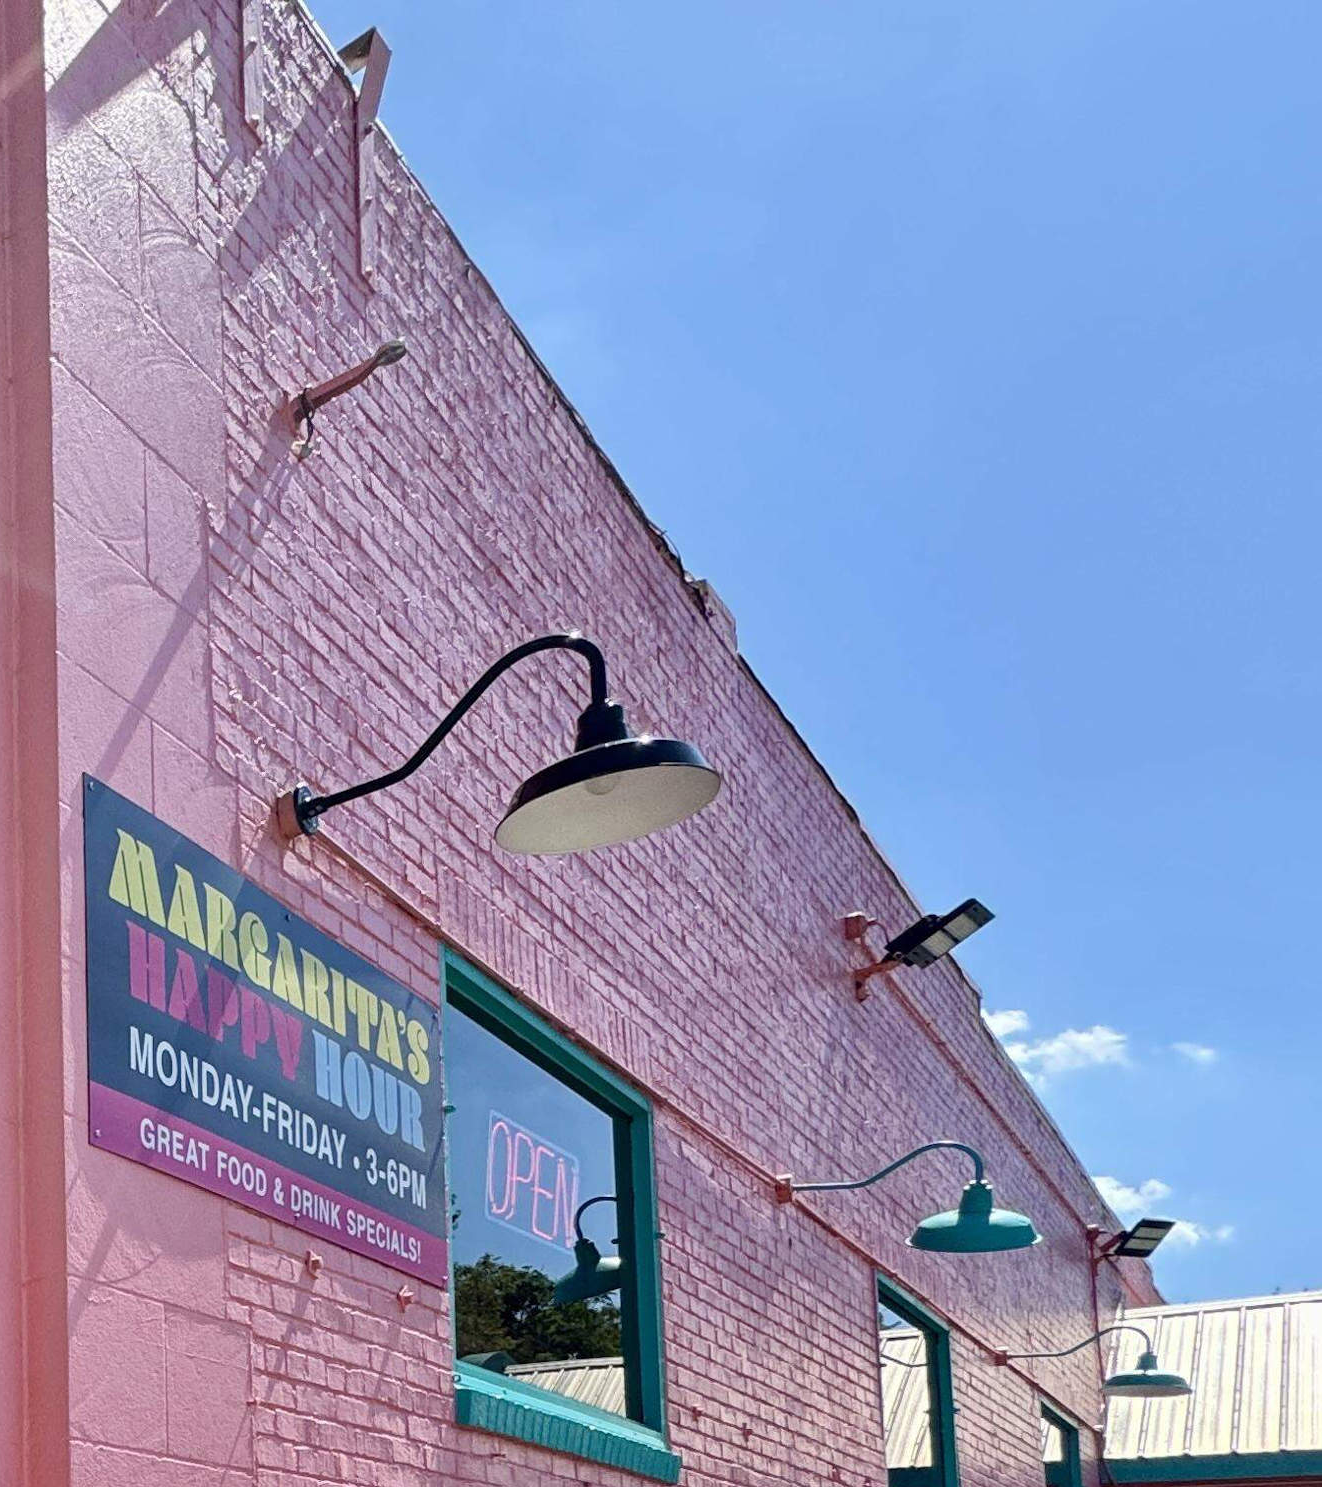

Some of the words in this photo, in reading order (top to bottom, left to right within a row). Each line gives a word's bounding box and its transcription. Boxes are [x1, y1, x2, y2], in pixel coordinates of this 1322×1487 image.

[108, 828, 431, 1085] MARGARITA'S
[126, 920, 304, 1083] HAPPY
[312, 1029, 427, 1154] HOUR
[129, 1025, 347, 1171] MONDAY-FRIDAY
[365, 1147, 428, 1210] 3-6PM
[139, 1117, 211, 1161] GREAT
[216, 1149, 269, 1198] FOOD
[273, 1181, 285, 1206] &
[290, 1188, 341, 1232] DRINK
[346, 1208, 422, 1265] SPECIALS!
[488, 1120, 578, 1249] OPEN
